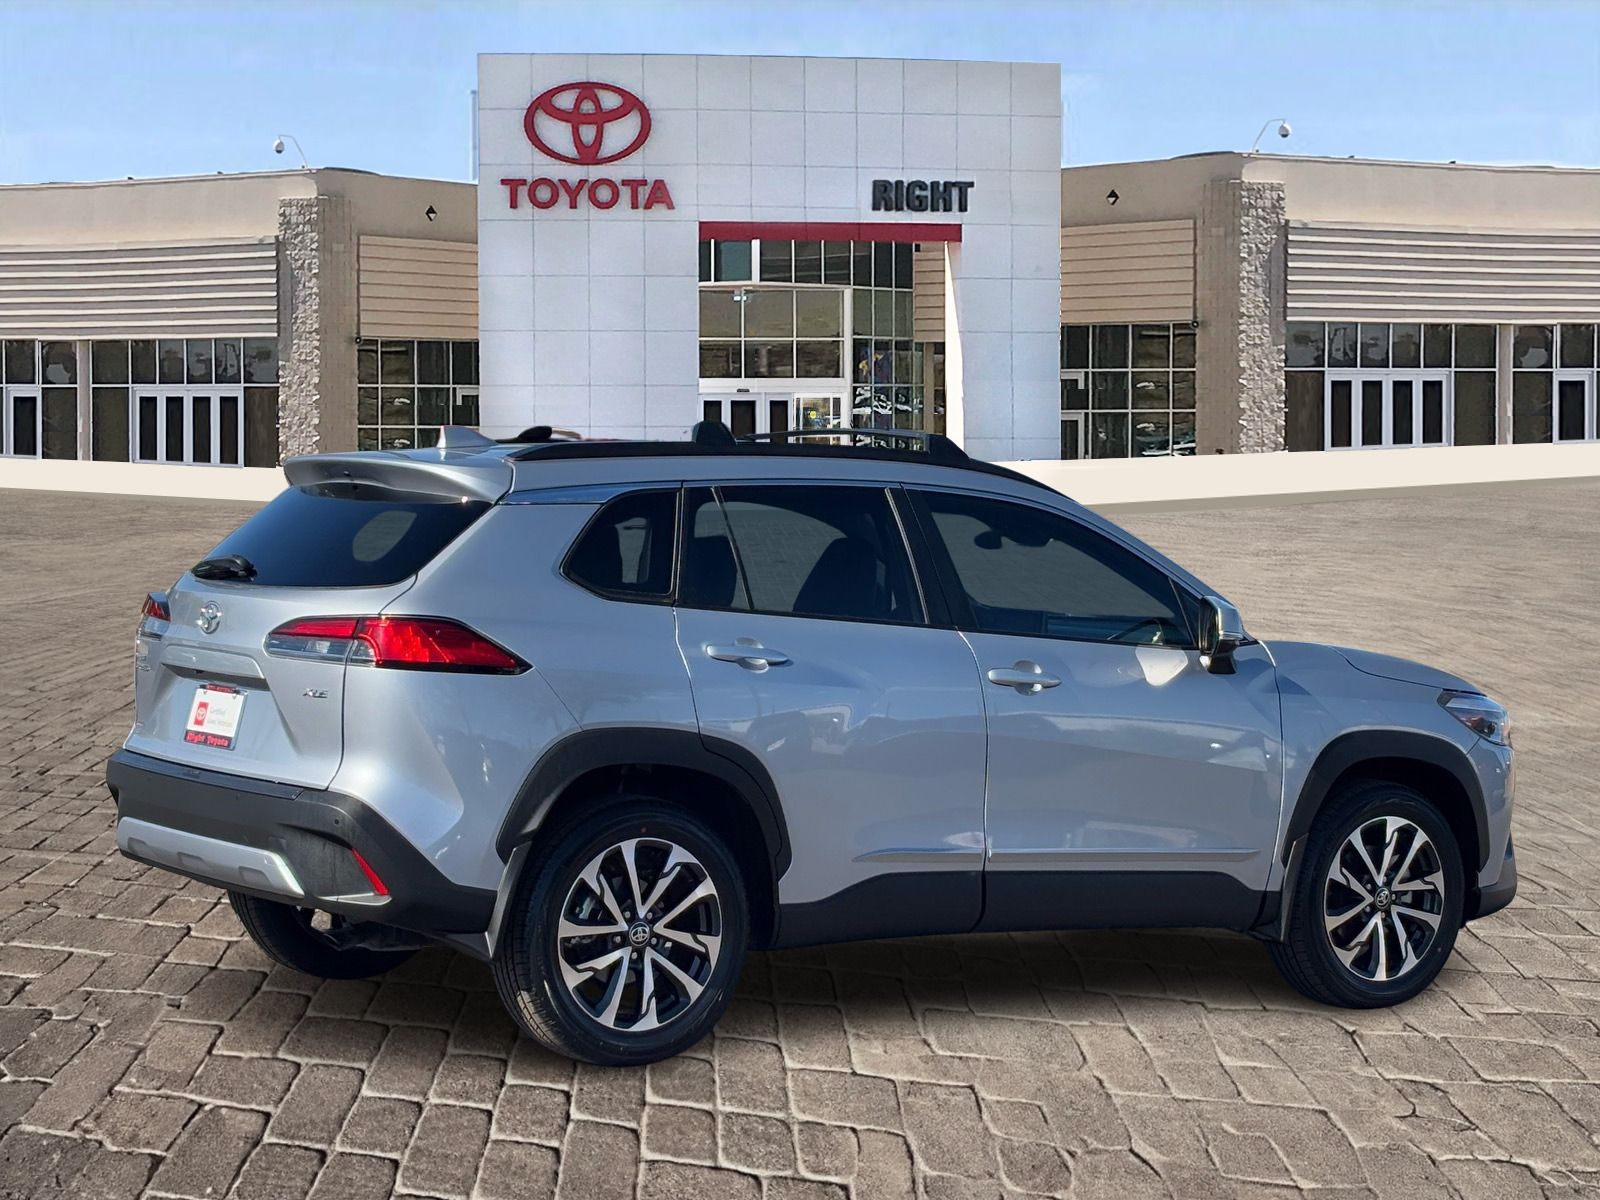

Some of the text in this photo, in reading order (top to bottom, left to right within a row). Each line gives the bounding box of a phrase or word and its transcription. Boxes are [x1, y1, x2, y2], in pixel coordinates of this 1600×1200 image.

[501, 178, 675, 210] TOYOTA
[871, 180, 975, 213] RIGHT
[187, 731, 230, 747] Right Toyota
